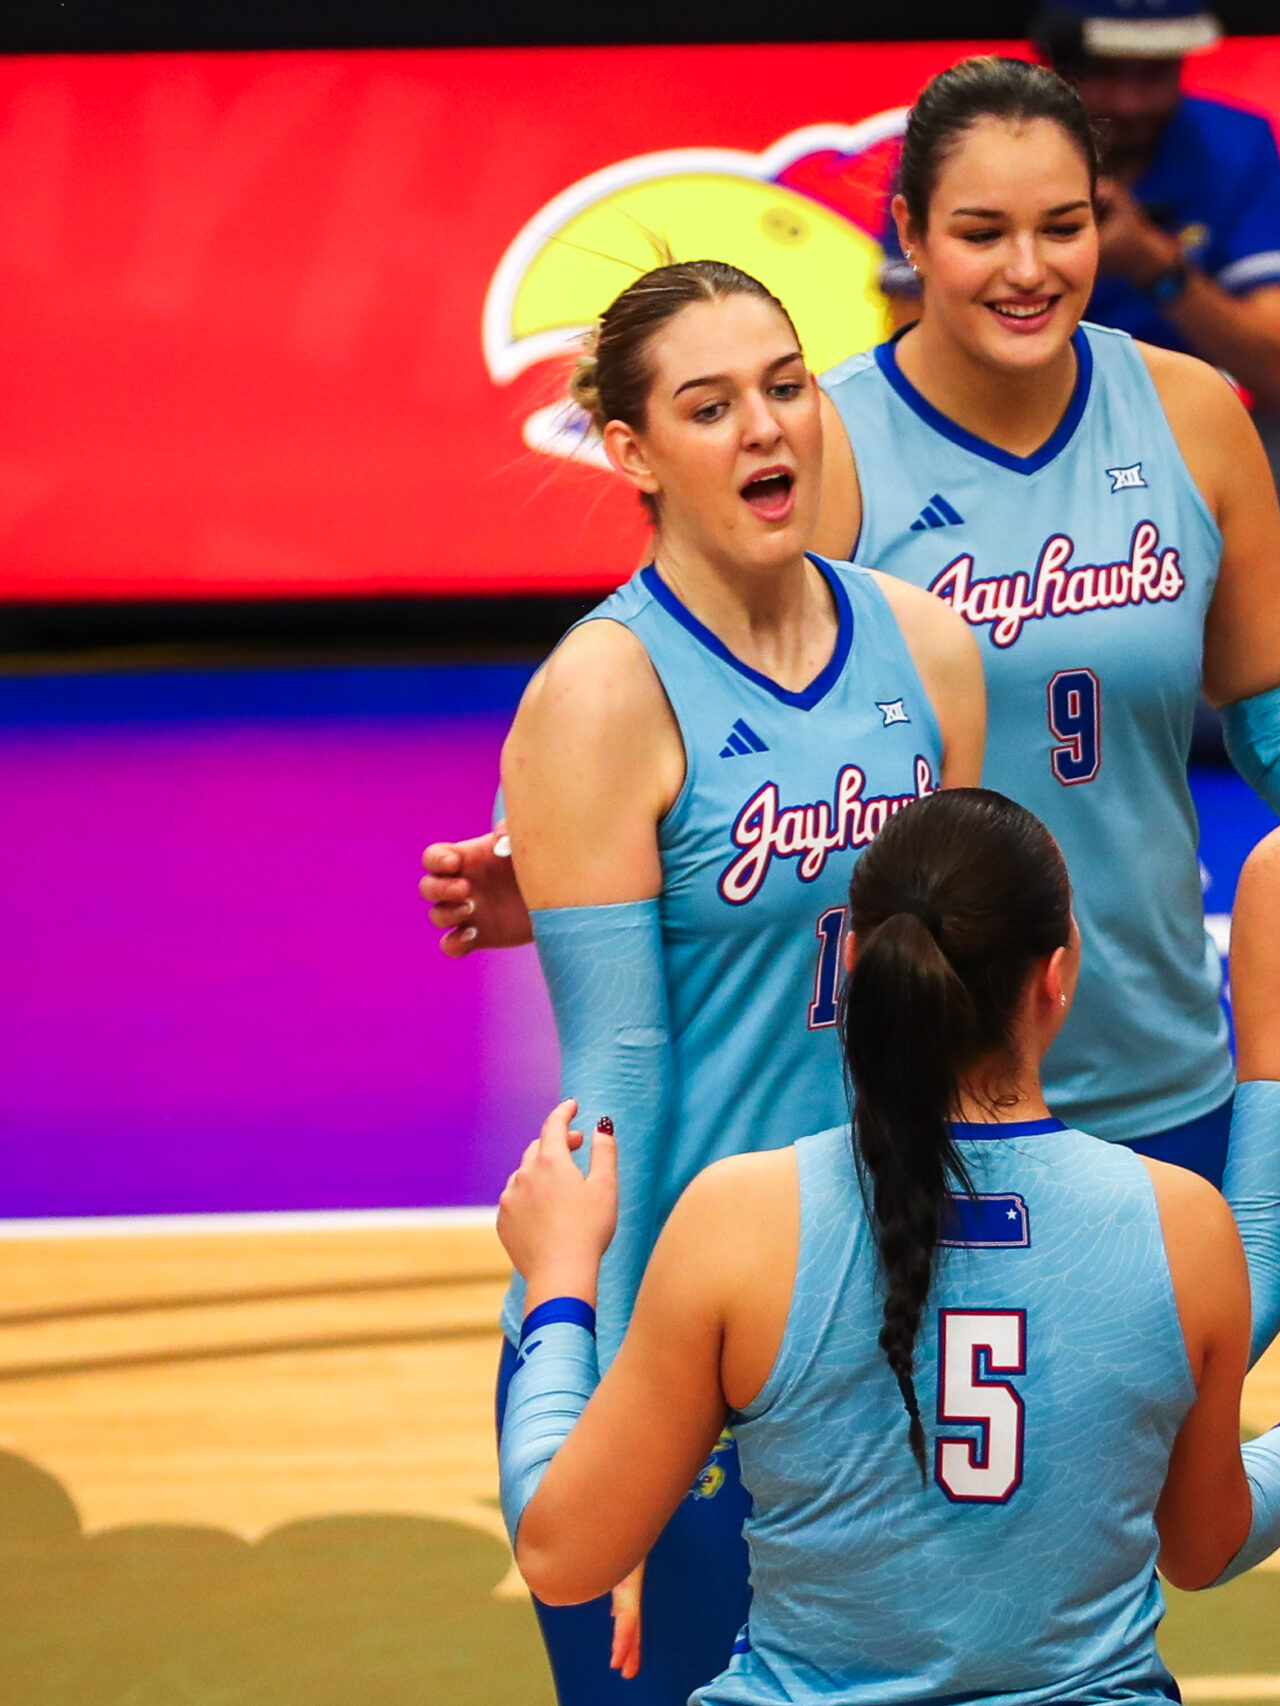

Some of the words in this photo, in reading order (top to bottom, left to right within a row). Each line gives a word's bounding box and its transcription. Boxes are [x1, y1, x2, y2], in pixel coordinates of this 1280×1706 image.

[1047, 667, 1102, 787] 9
[717, 754, 941, 906] Jayhak
[934, 1308, 1027, 1505] 5
